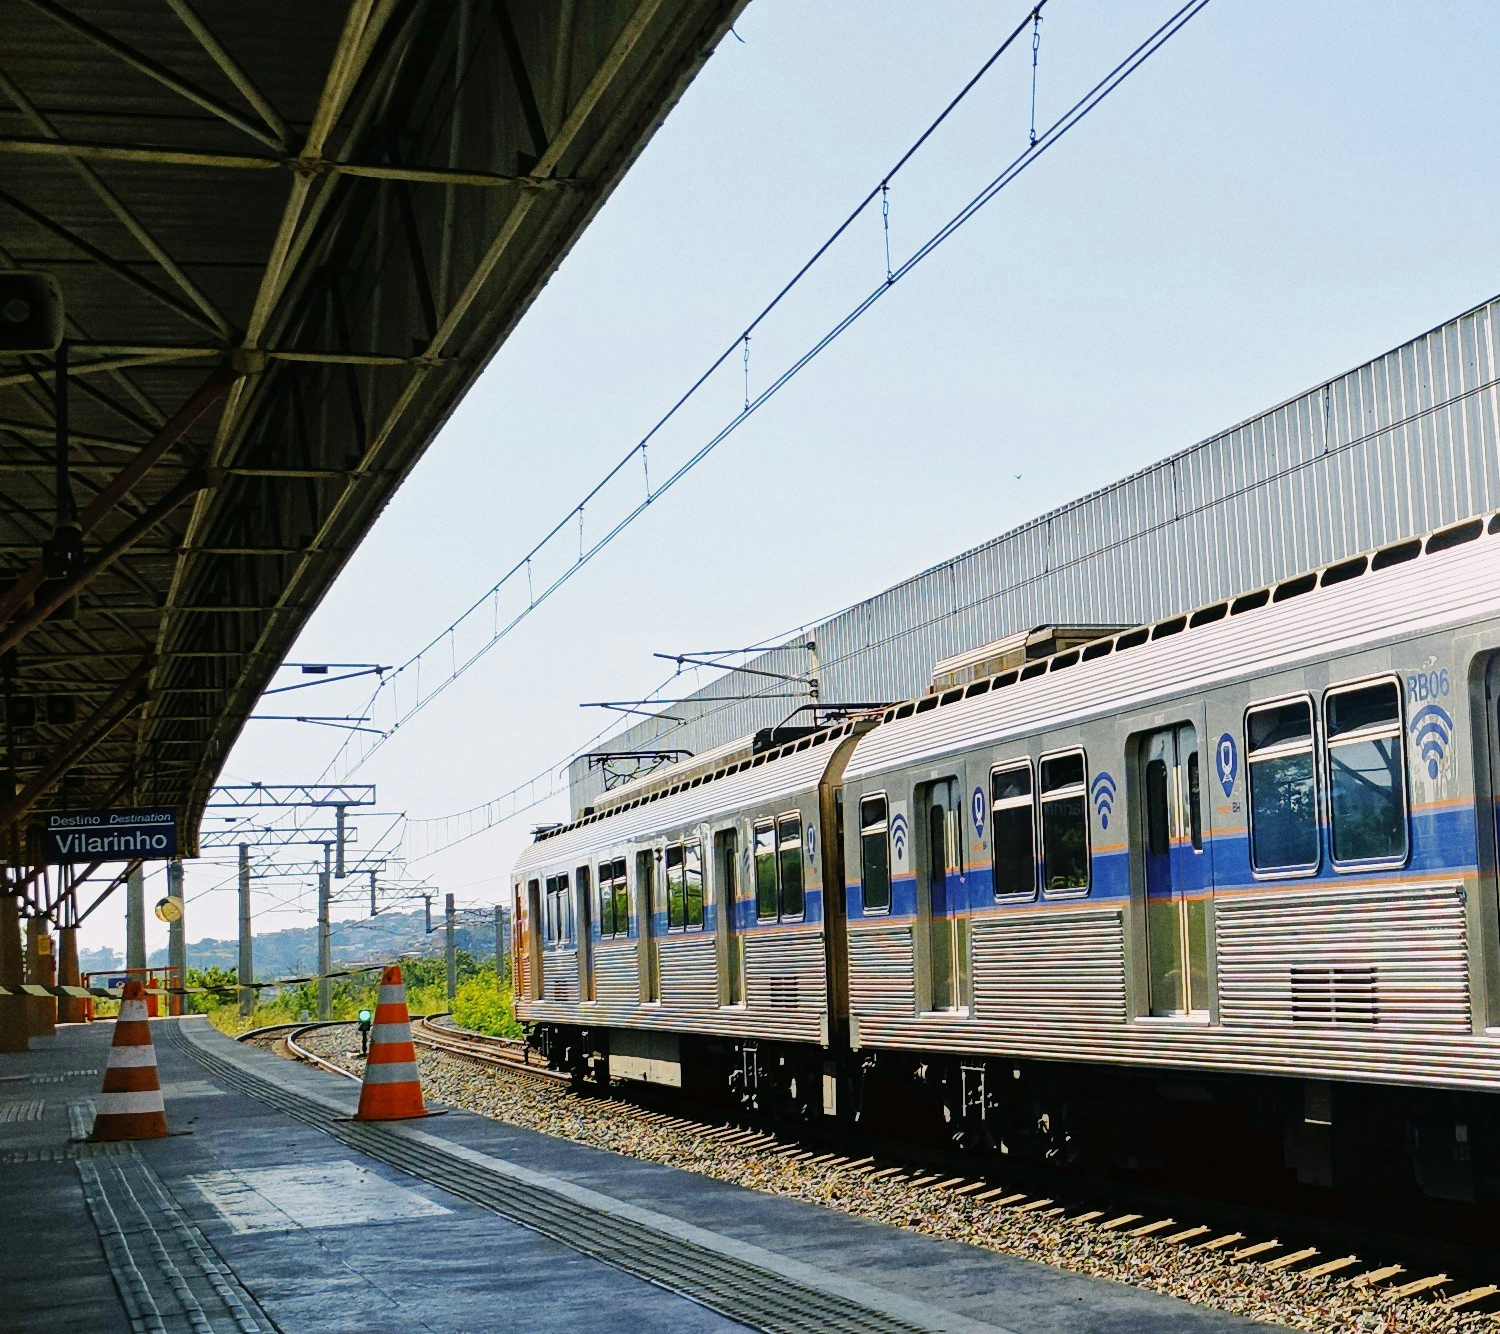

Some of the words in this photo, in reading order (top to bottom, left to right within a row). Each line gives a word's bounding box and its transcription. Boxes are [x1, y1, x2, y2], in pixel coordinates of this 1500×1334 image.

[1406, 668, 1450, 703] RB06
[50, 814, 101, 827] Destino
[109, 812, 171, 825] Destination
[55, 830, 168, 854] Vilarinho
